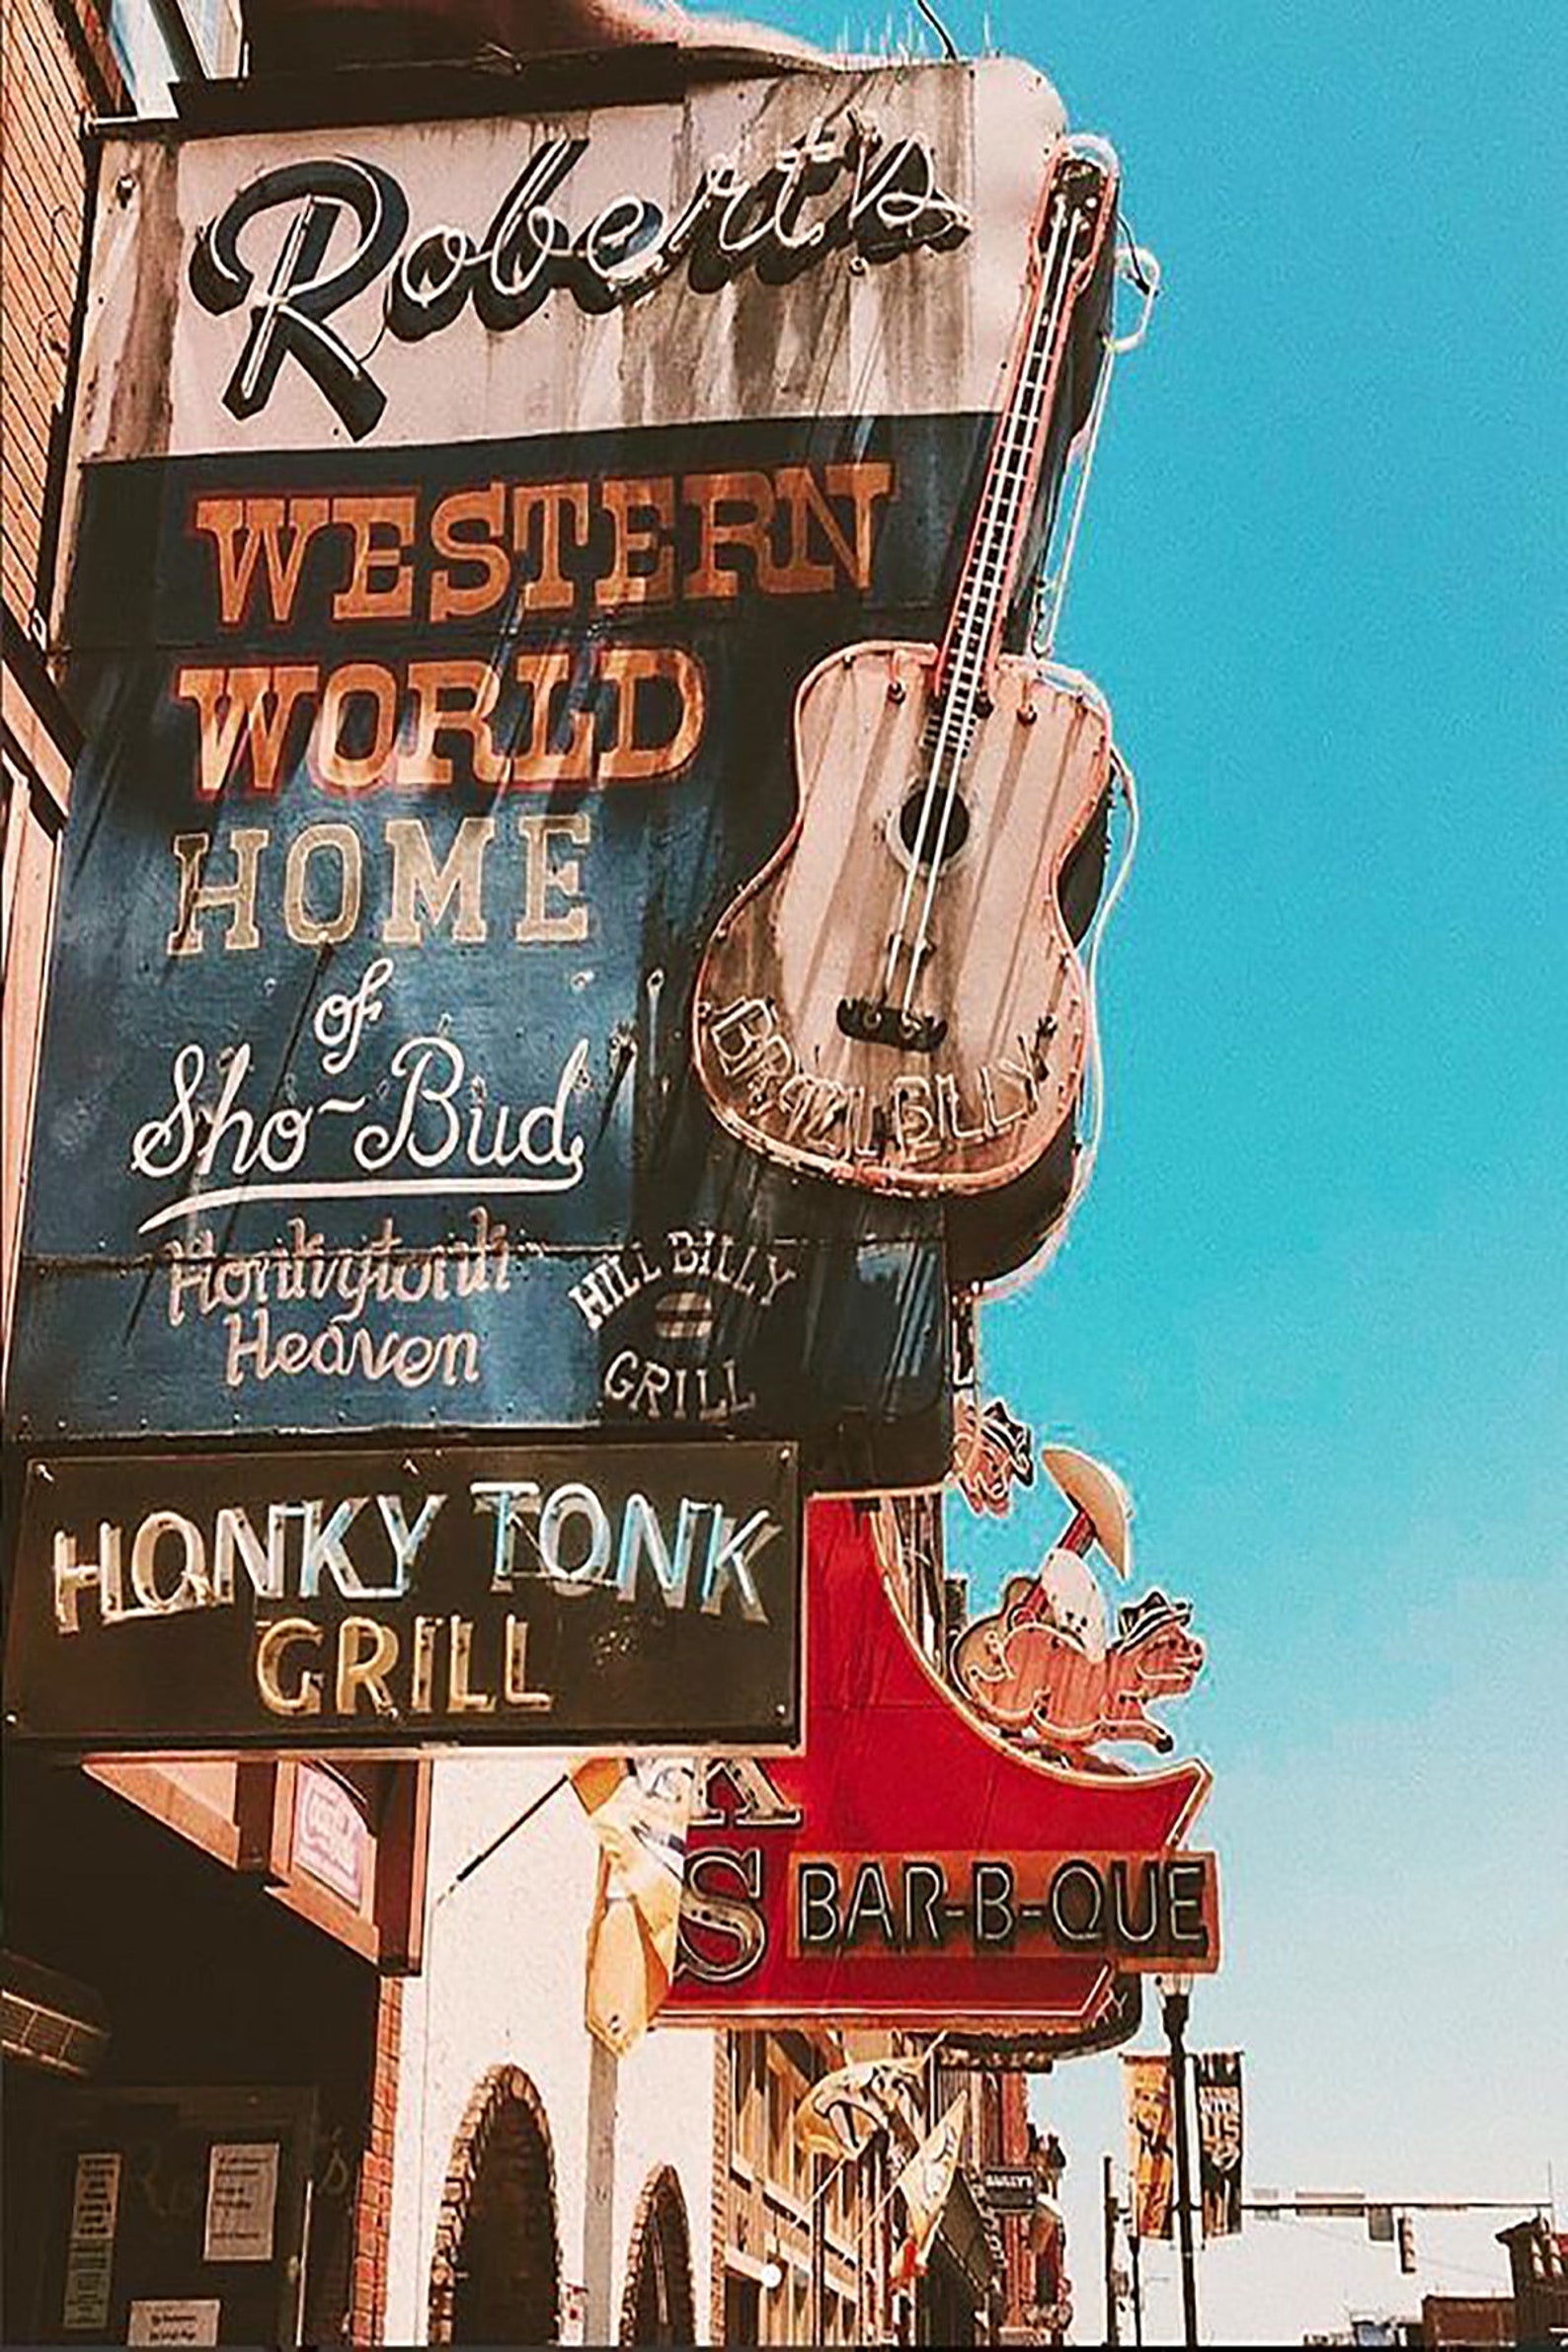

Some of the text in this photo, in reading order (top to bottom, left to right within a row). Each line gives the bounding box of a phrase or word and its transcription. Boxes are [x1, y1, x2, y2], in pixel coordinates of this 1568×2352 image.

[189, 110, 972, 442] Robert's
[194, 460, 897, 632] WESTERN
[175, 646, 707, 800] WORLD
[166, 813, 591, 957] HOME
[312, 958, 393, 1075] of
[568, 1230, 797, 1331] HILL BILLY
[222, 1305, 481, 1388] Heaven
[603, 1350, 757, 1420] GRILL
[53, 1481, 784, 1636] HONKY TONK
[255, 1613, 554, 1716] GRILL
[798, 1860, 1210, 1955] BAR-B-QUE
